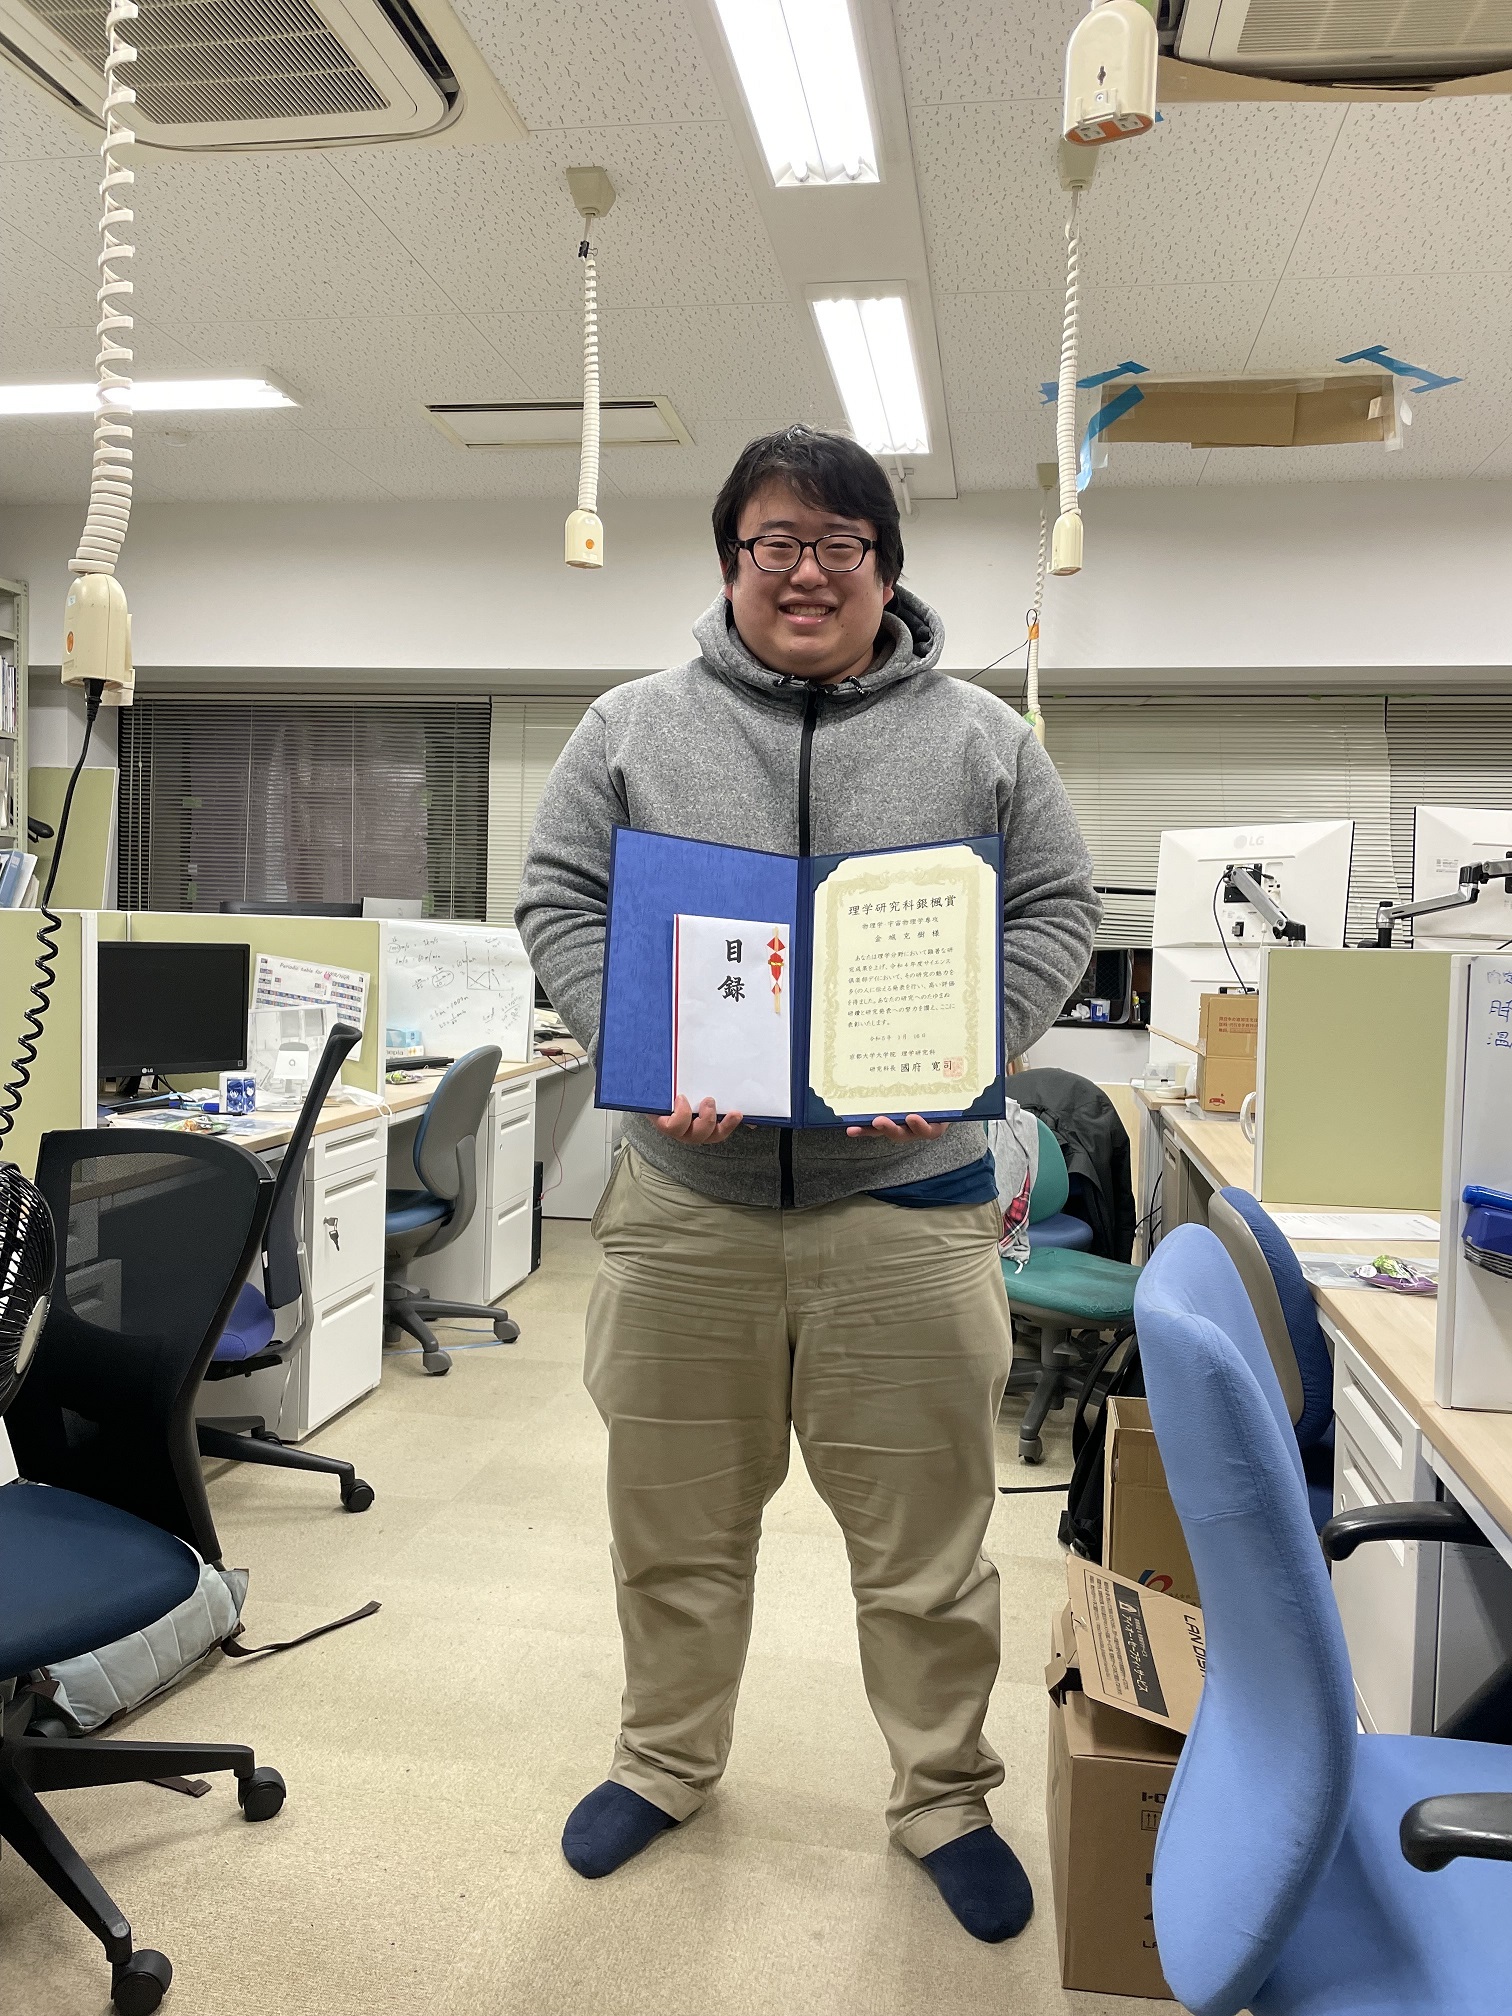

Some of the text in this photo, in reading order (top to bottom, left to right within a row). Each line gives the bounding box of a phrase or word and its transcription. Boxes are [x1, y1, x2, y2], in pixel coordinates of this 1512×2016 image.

[848, 895, 957, 916] 理学研究科銀楓賞
[717, 939, 746, 1003] 目録
[849, 1049, 936, 1060] 京都大学大学院 理学研究科
[1183, 1614, 1204, 1646] LAN
